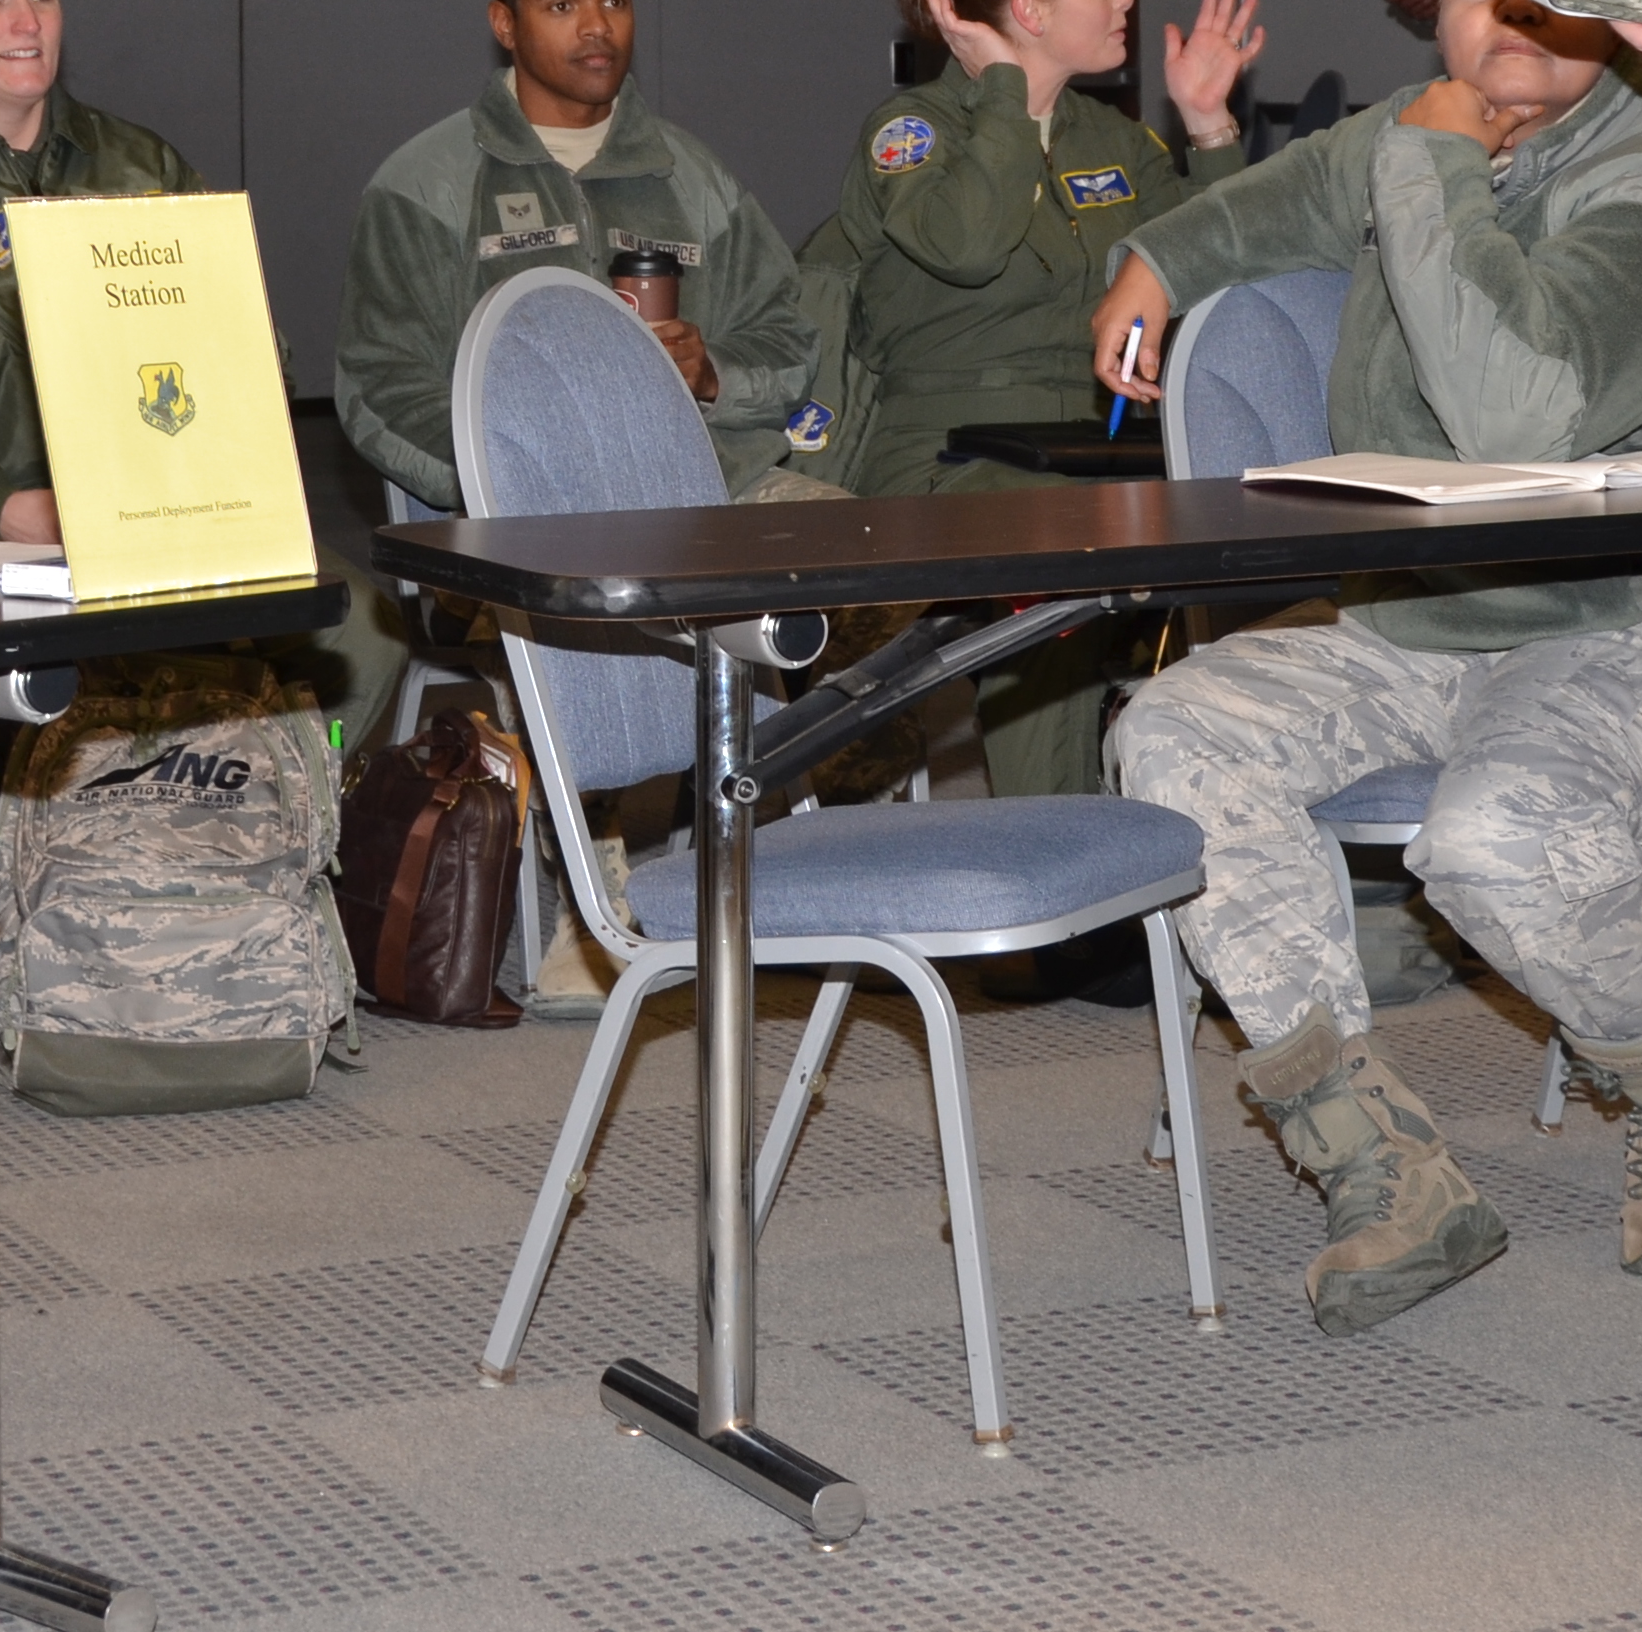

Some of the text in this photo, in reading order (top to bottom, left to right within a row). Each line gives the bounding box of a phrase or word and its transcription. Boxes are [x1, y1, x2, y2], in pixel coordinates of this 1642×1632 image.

[500, 229, 556, 250] GILFORD
[620, 232, 635, 249] US
[89, 238, 184, 269] Medical
[104, 279, 186, 309] Station
[118, 499, 252, 521] Personnel Deployment Function
[79, 742, 251, 790] ANG
[75, 791, 101, 802] AIR
[108, 785, 185, 799] NATIONAL
[193, 791, 245, 805] GUARD
